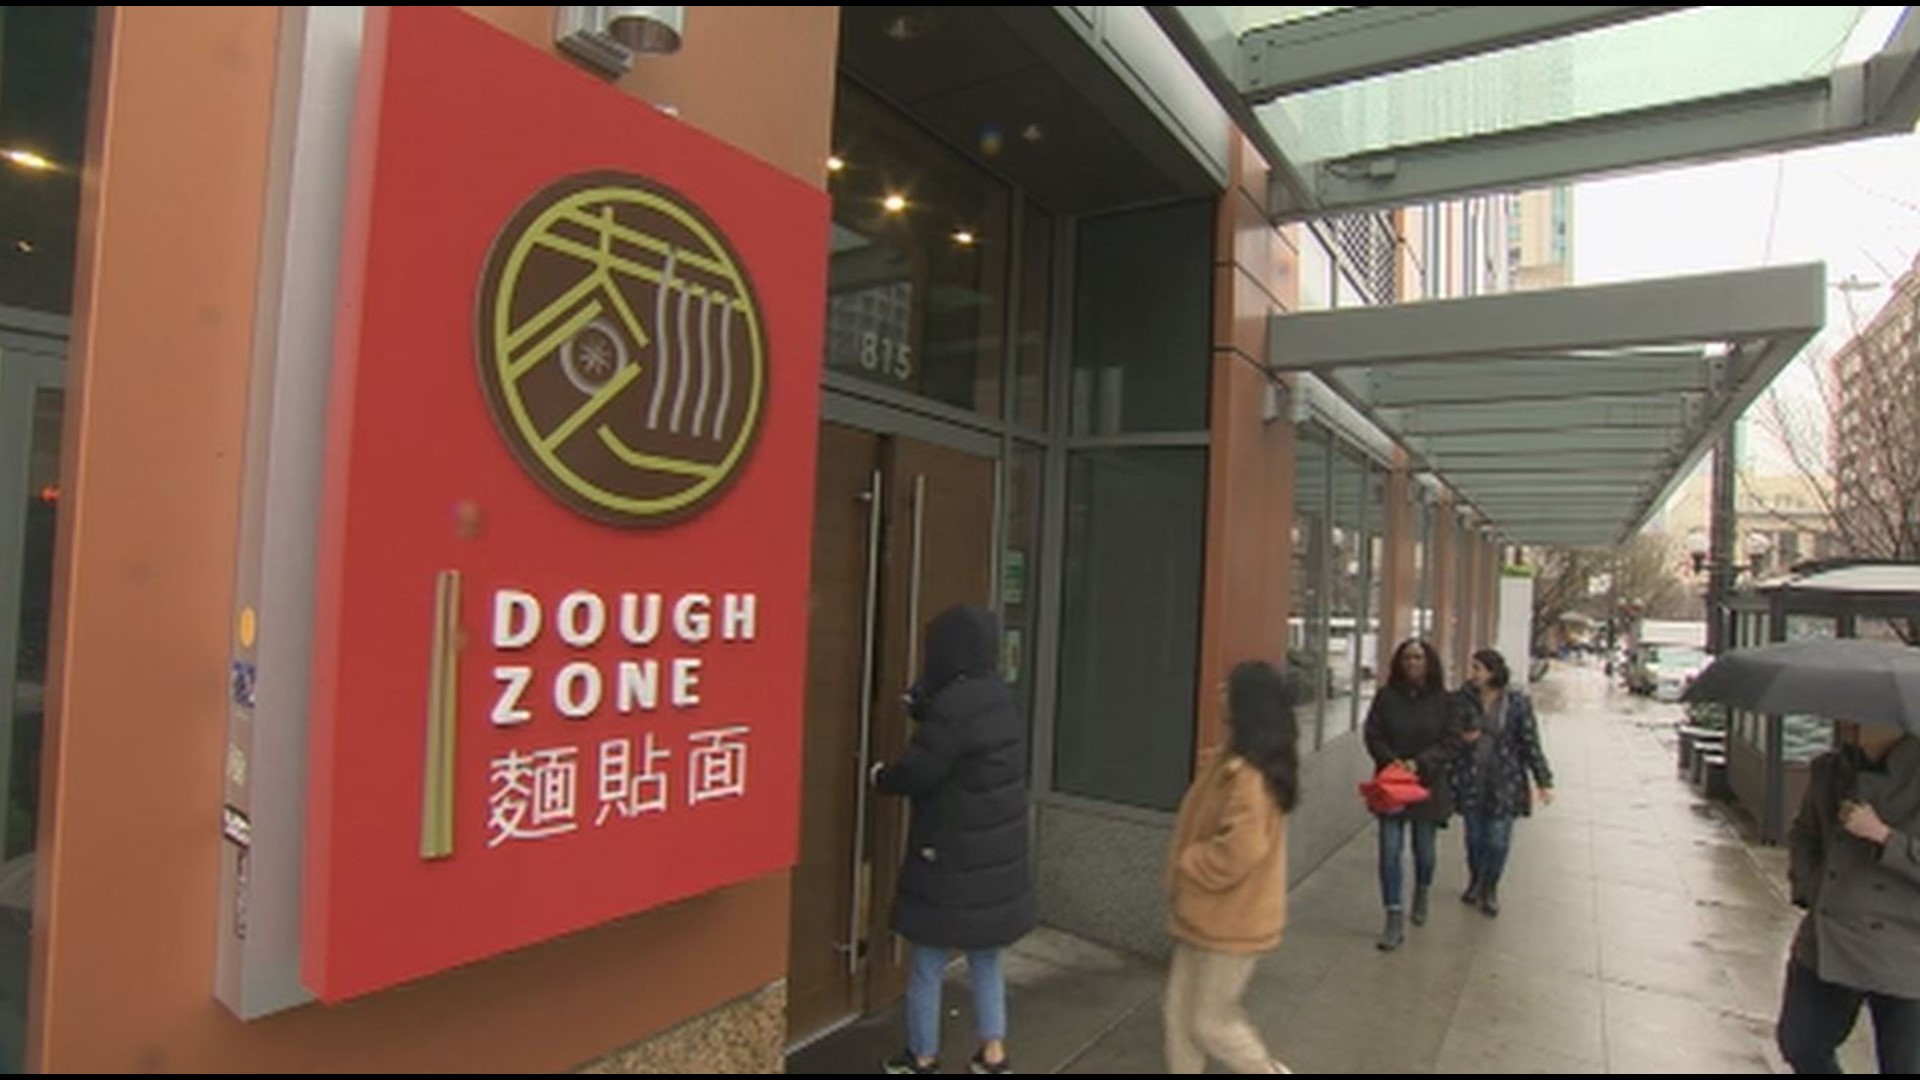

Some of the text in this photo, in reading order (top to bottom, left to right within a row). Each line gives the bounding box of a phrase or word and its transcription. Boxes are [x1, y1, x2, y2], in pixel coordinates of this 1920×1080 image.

[861, 331, 911, 380] 815
[492, 589, 757, 648] DOUGH
[490, 658, 702, 724] ZONE
[487, 725, 751, 847] 麵貼面
